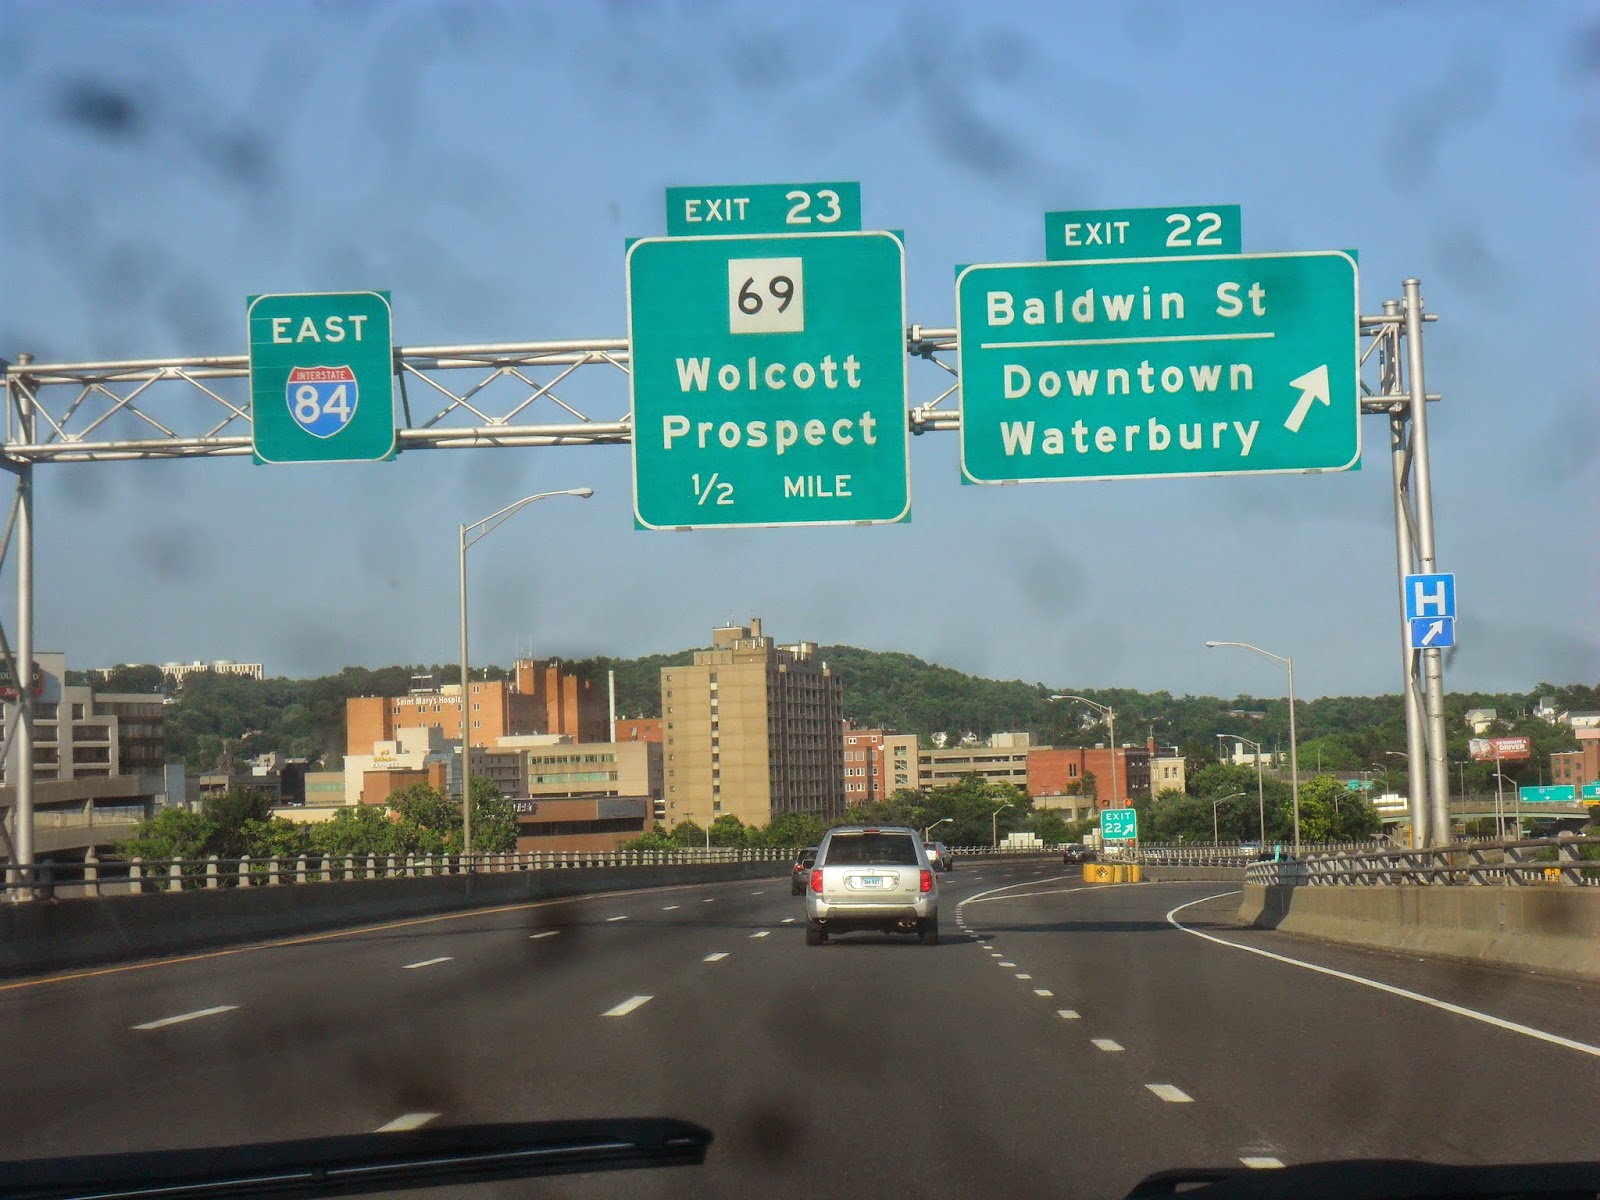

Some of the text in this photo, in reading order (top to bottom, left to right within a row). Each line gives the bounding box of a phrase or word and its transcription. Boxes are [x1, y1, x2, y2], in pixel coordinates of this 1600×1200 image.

[685, 190, 842, 225] EXIT 23
[1064, 212, 1222, 247] EXIT 22
[737, 275, 794, 315] 69
[986, 281, 1267, 326] Baldwin St
[272, 315, 368, 344] EAST
[296, 370, 346, 381] INTERSTATE
[675, 354, 862, 392] Wolcott
[1003, 359, 1254, 399] Downtown
[294, 384, 351, 424] 84
[663, 411, 877, 456] Prospect
[1000, 416, 1260, 457] Waterbury
[691, 472, 852, 506] 1/2 MILE
[1415, 581, 1445, 616] H
[396, 697, 415, 706] Saint
[415, 696, 437, 707] Mary's
[1499, 743, 1525, 751] DRIVER
[1105, 822, 1122, 833] 22
[1106, 812, 1131, 821] EXIT
